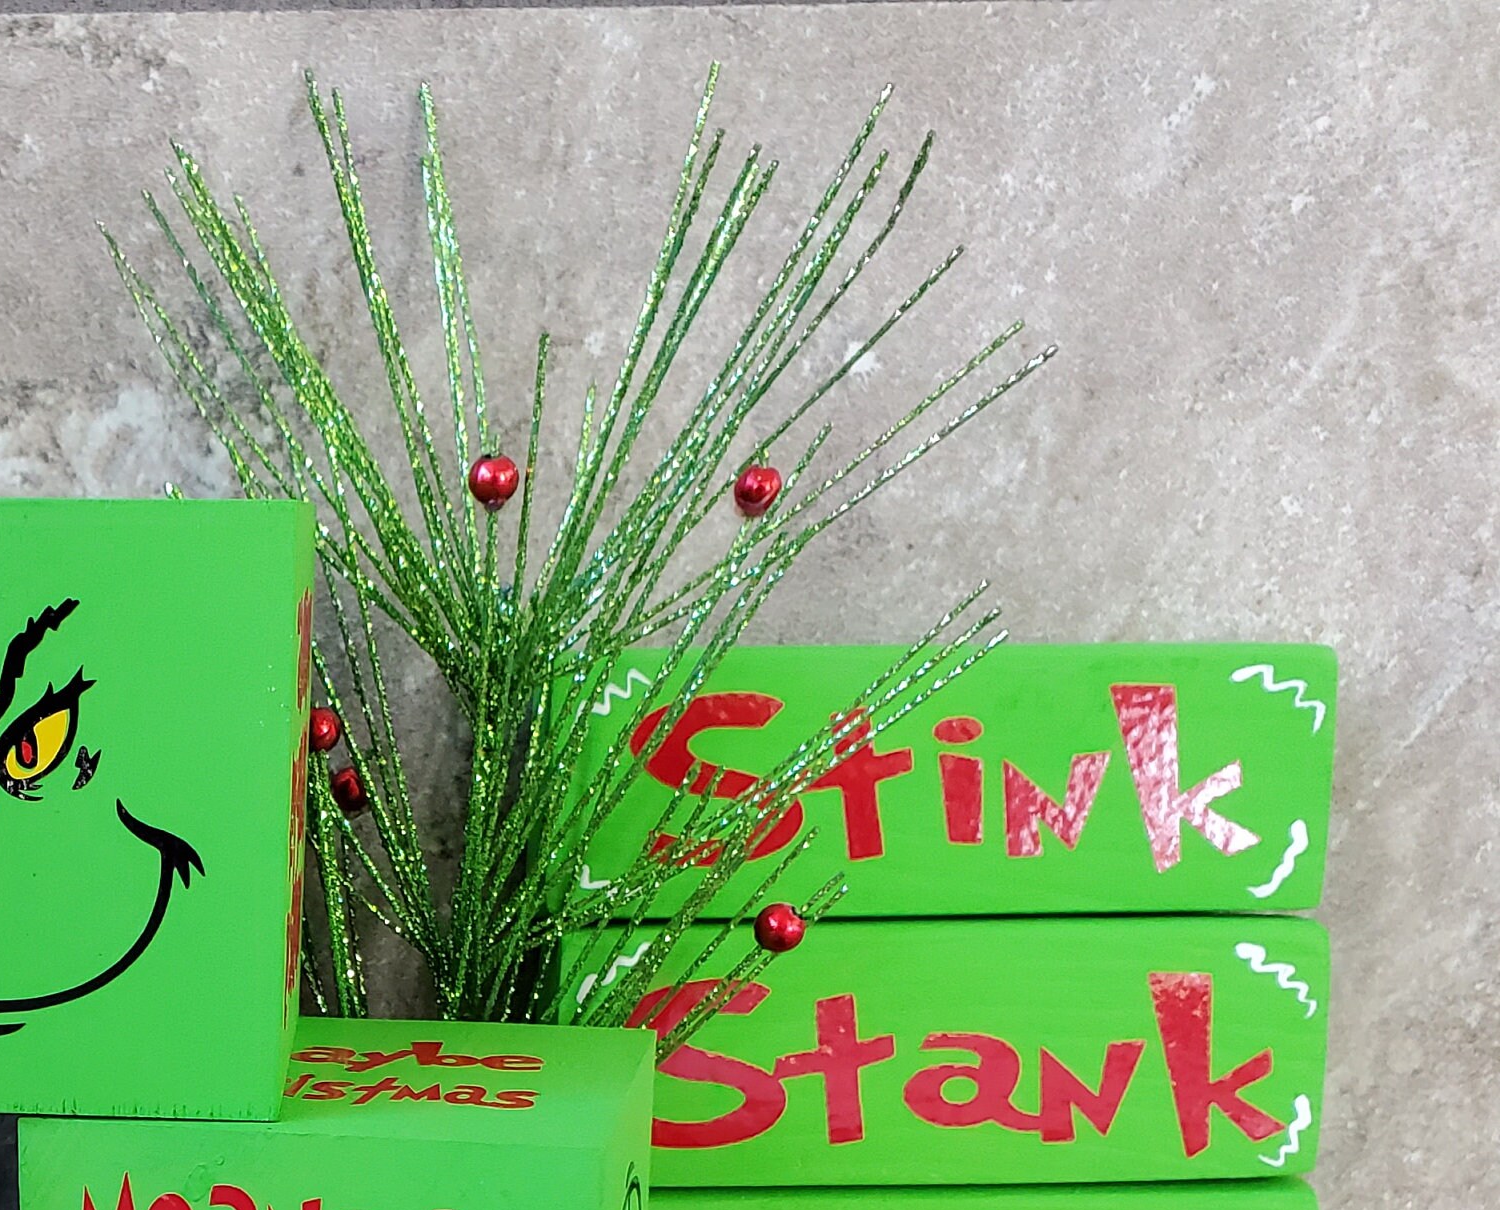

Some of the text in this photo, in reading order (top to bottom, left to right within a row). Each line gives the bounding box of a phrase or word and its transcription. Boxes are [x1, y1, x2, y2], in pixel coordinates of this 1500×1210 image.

[628, 684, 1263, 873] Stink
[283, 1074, 540, 1109] istmas
[290, 1040, 544, 1072] aybe
[624, 972, 1287, 1158] Stank
